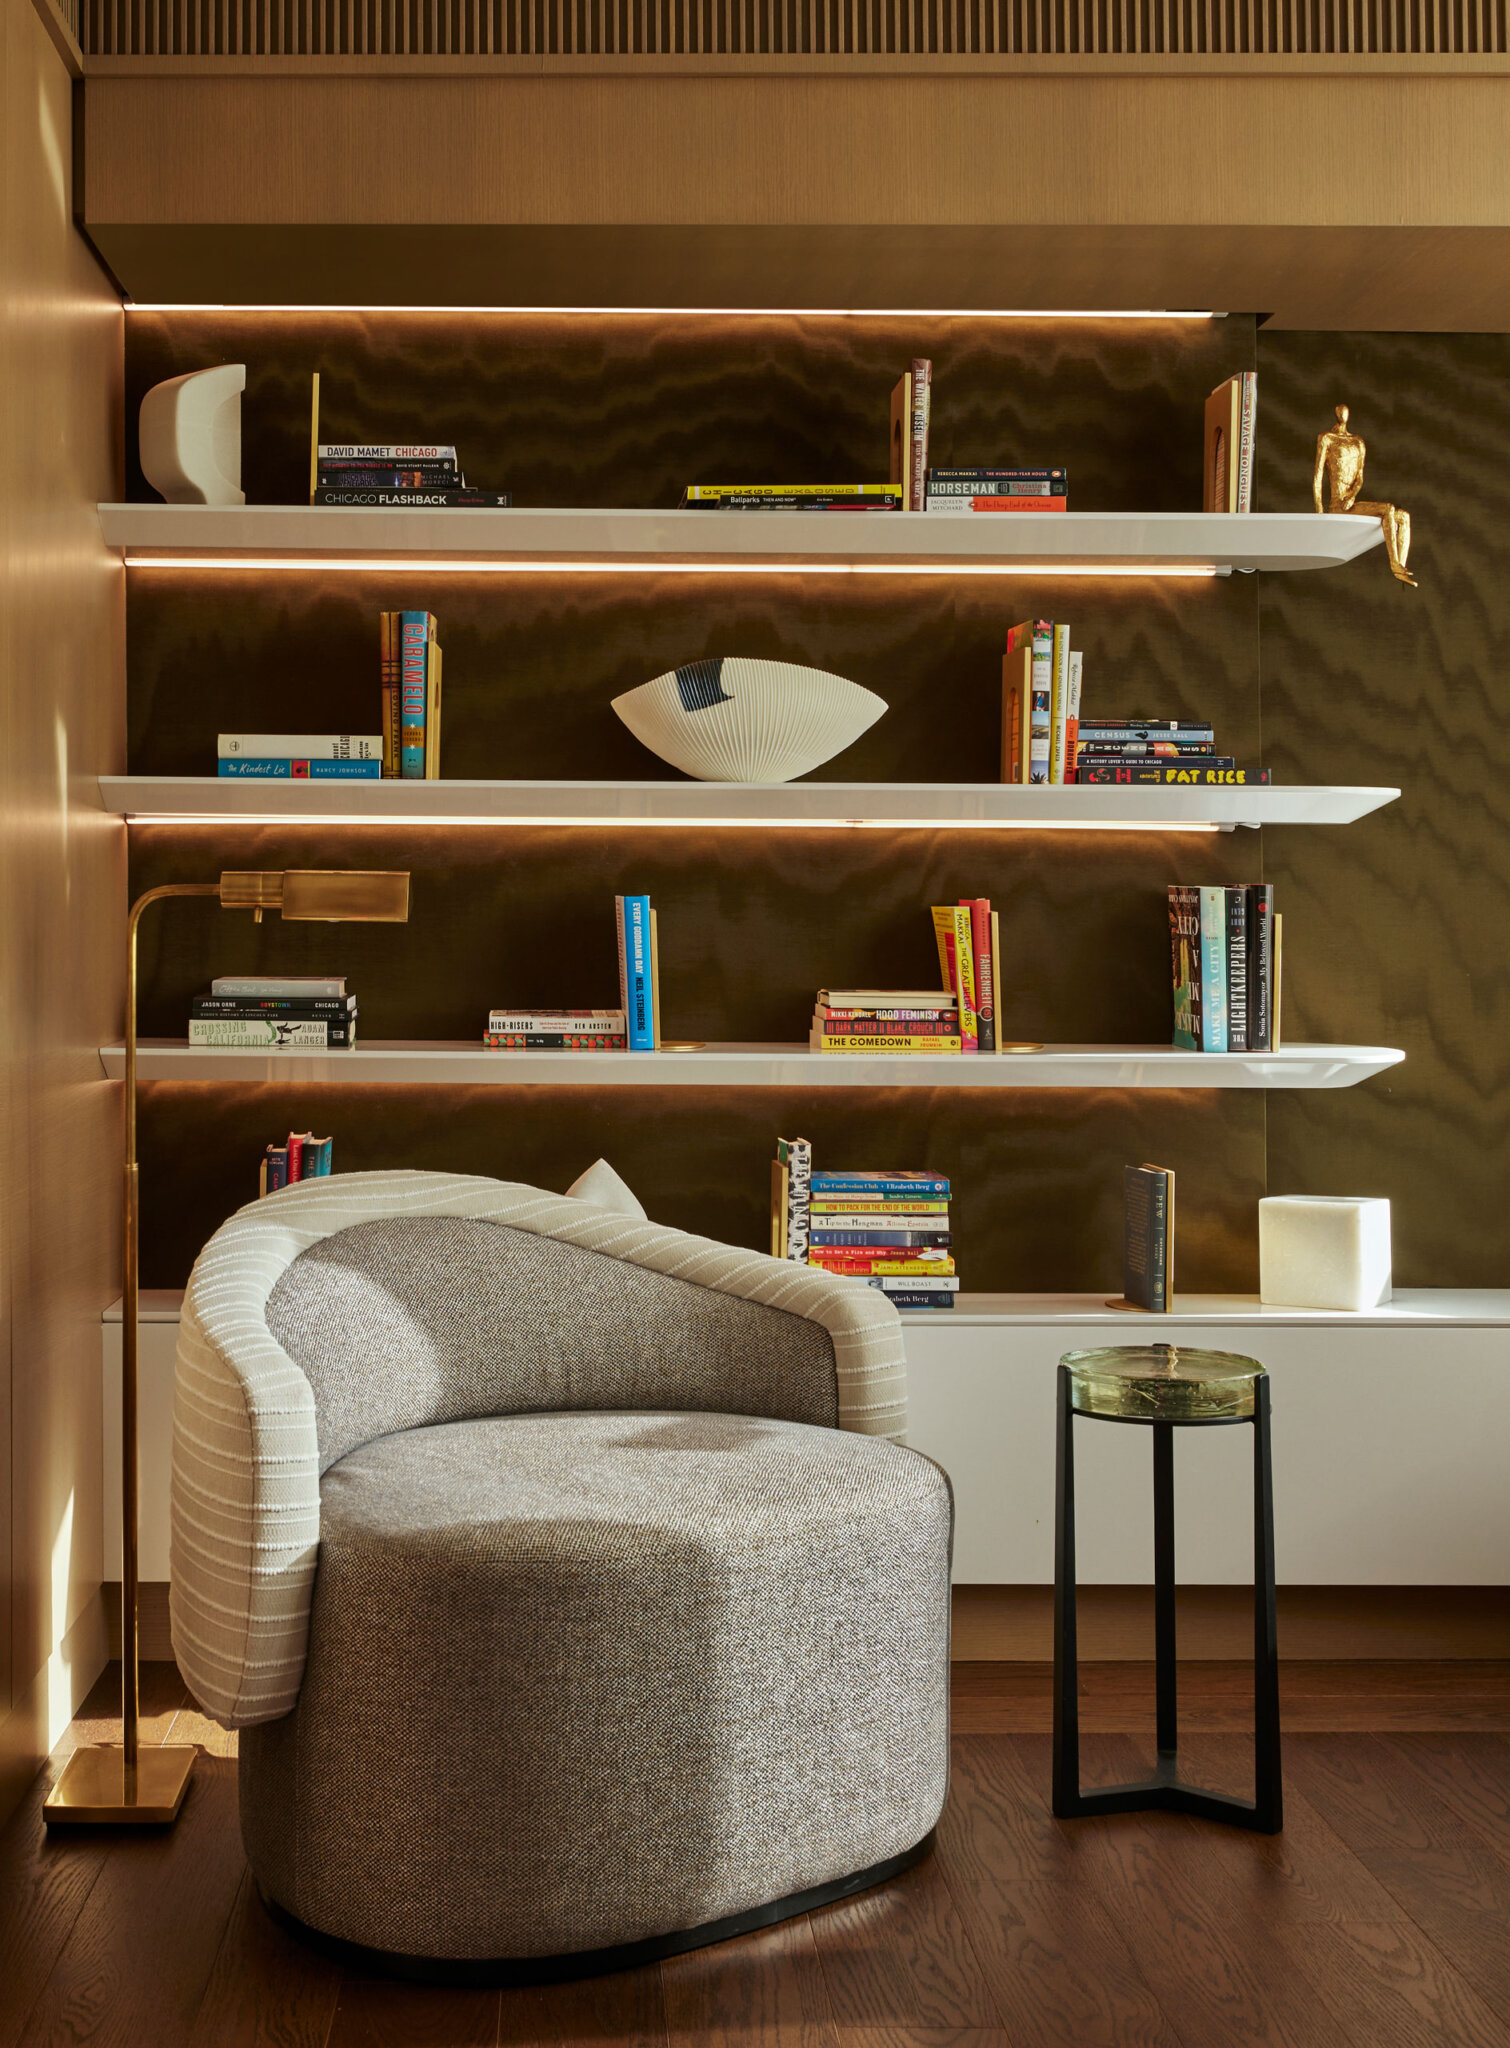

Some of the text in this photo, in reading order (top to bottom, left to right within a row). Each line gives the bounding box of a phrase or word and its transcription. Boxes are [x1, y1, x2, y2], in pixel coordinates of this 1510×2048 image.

[914, 369, 924, 441] THE WATER MUSEUM
[1241, 409, 1250, 450] SAVAGE
[327, 447, 391, 457] DAVID MAMET
[395, 448, 438, 457] CHICAGO
[1240, 454, 1250, 505] TONGUES
[931, 484, 995, 494] HORSEMAN
[325, 494, 376, 503] CHICAGO
[379, 494, 447, 505] FLASHBACK
[403, 624, 424, 715] CARAMELO
[228, 763, 285, 775] The Kindest Lie
[1166, 769, 1245, 784] FAT RICE
[632, 902, 643, 974] EVERY GODDAMN DAY
[1210, 945, 1219, 973] CITY
[980, 954, 992, 1004] FAHRENHEIT
[1260, 967, 1268, 976] My
[1231, 936, 1246, 1032] LIGHTKEEPERS
[636, 977, 645, 1031] NEIL STEINBERG
[1210, 987, 1220, 1007] ME
[1259, 981, 1268, 1016] Sotomayor
[963, 986, 972, 1026] BELIEVERS
[876, 1010, 939, 1020] HOOD FEMINISM
[193, 1022, 247, 1036] CROSSING
[301, 1024, 325, 1033] ADAM
[491, 1021, 533, 1030] HIGH-RISERS
[836, 1023, 877, 1032] DARK MATTER
[886, 1024, 933, 1032] BLAKE CROUCH
[1210, 1011, 1221, 1046] MAKE
[206, 1034, 270, 1044] CALIFORNIA
[293, 1036, 325, 1044] LANGER
[796, 1156, 807, 1176] THE
